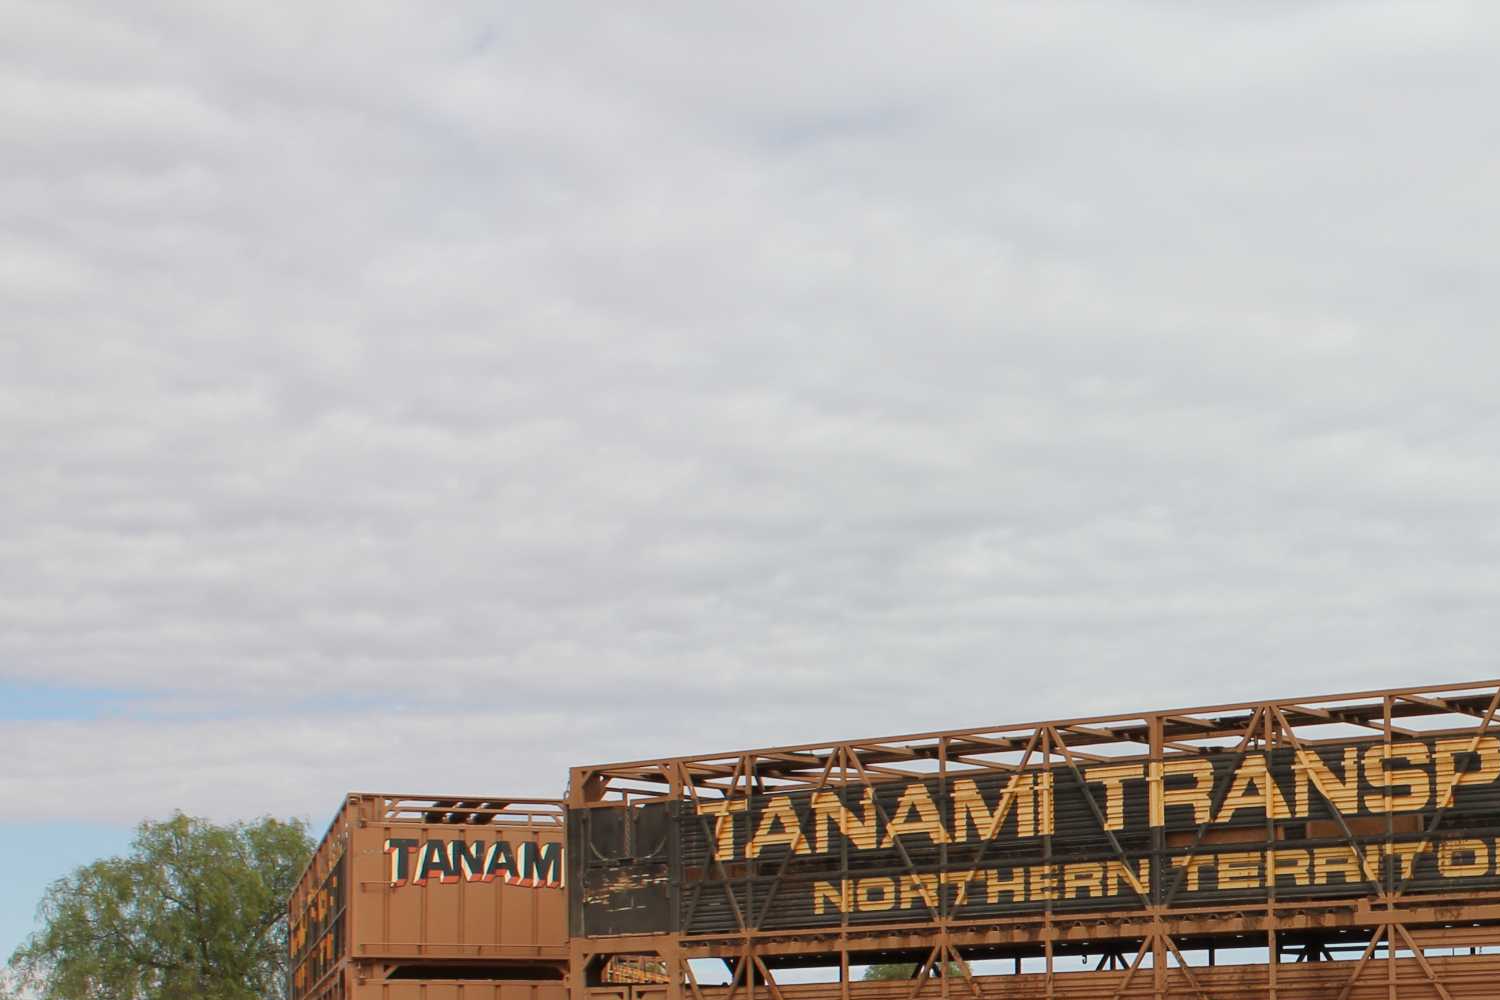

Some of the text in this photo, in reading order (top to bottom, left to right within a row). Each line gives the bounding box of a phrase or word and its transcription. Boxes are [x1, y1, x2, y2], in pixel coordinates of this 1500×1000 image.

[696, 770, 1055, 862] TANAMI
[384, 838, 565, 888] TANAM
[812, 858, 1151, 915] NORTHERN
